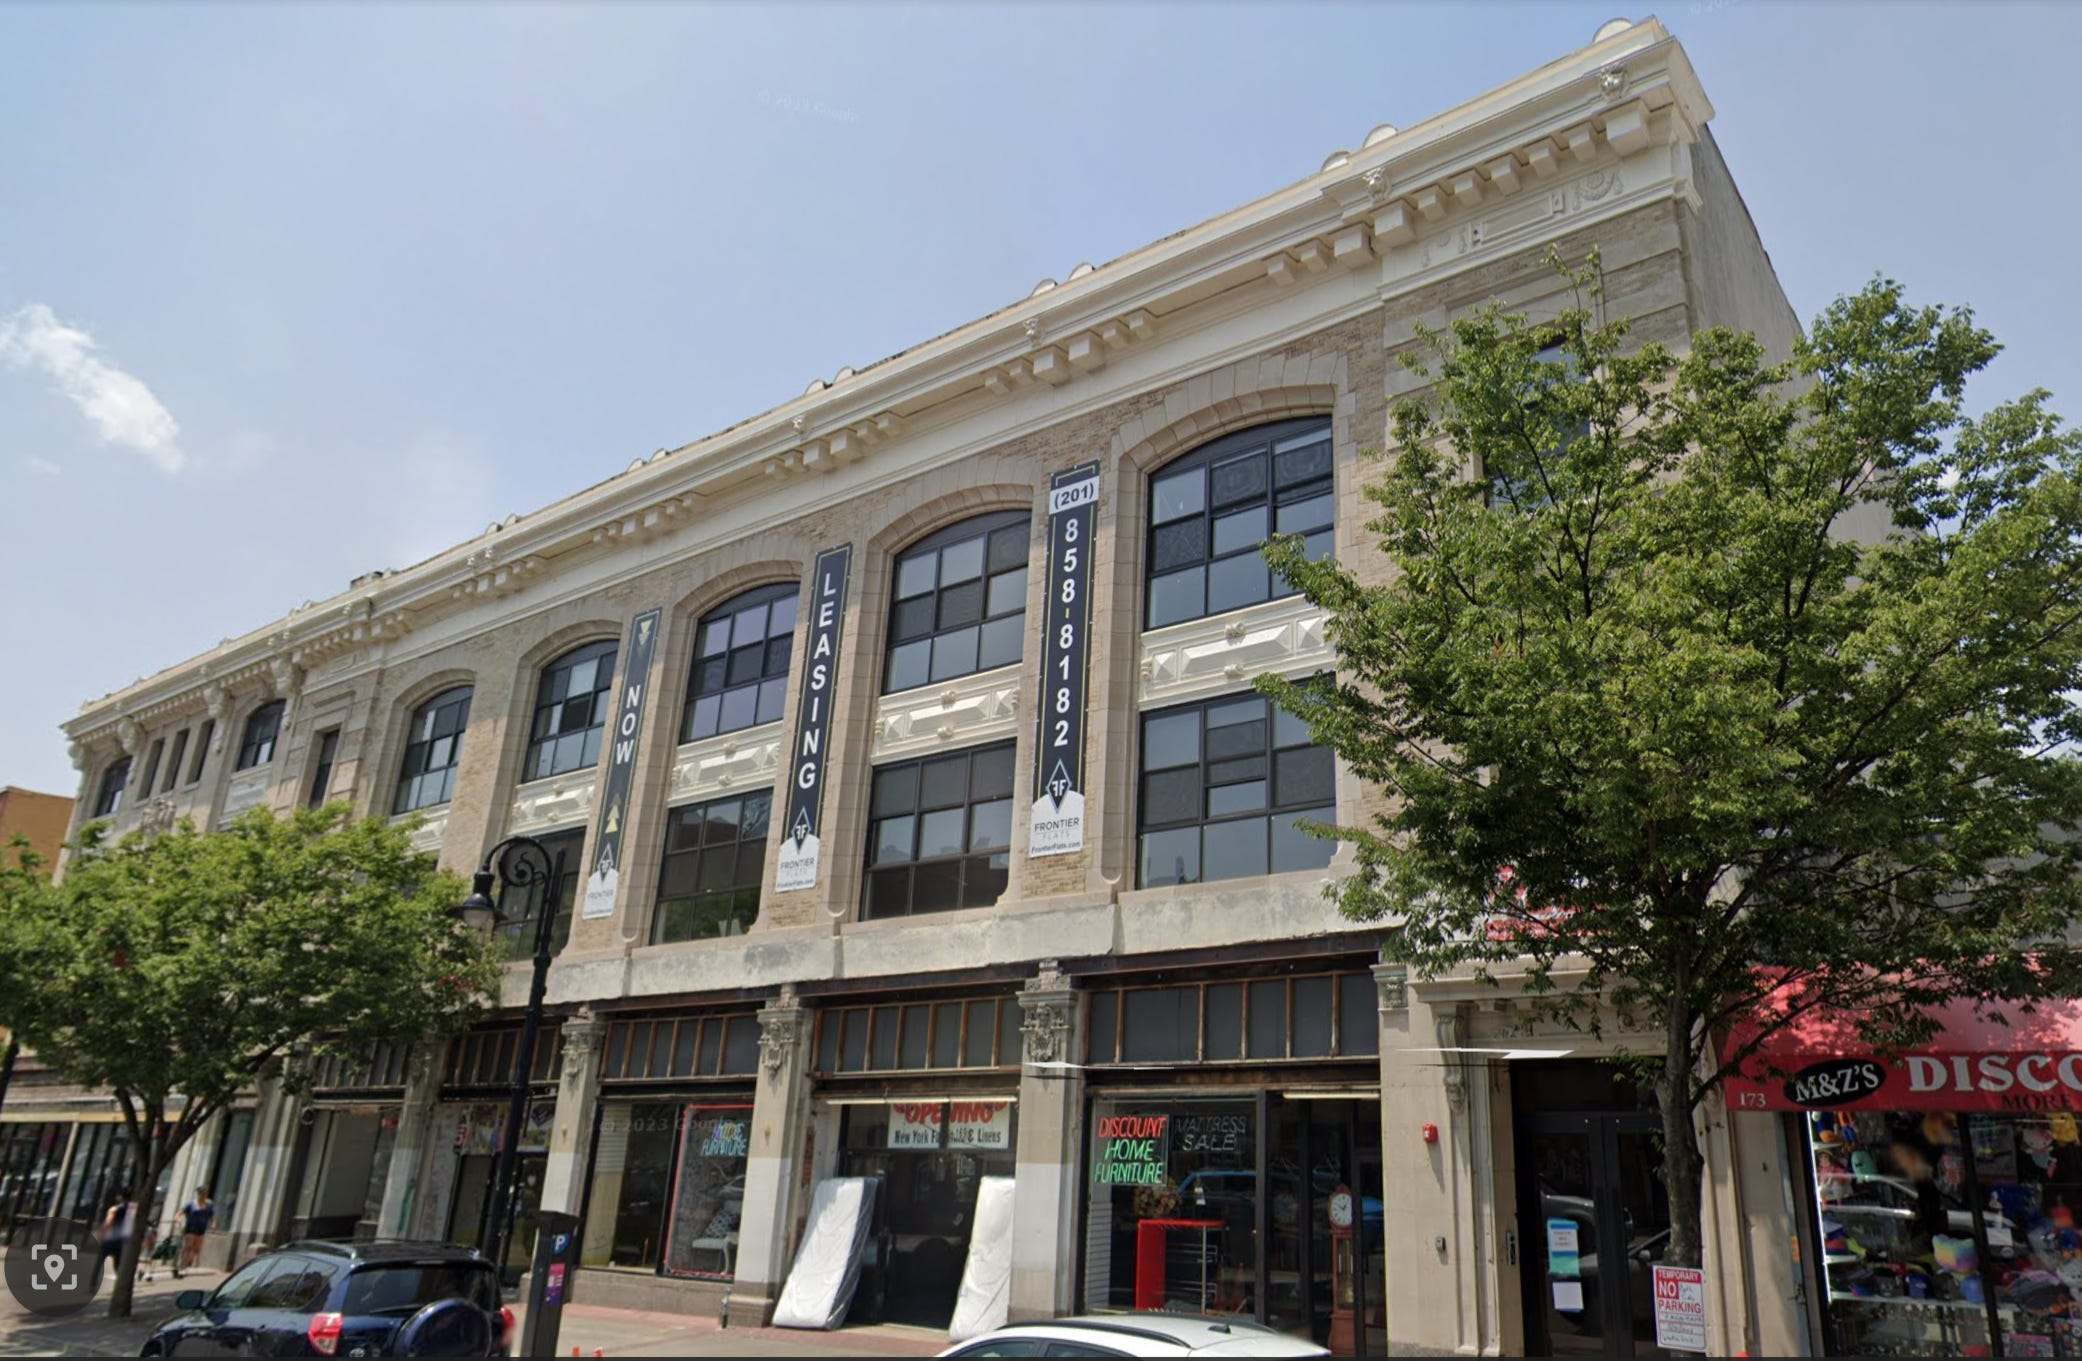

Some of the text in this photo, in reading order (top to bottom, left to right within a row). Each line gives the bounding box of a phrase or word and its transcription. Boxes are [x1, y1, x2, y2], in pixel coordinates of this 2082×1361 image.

[1054, 483, 1094, 511] (201)
[799, 572, 837, 790] LEASING
[616, 684, 641, 765] NOW
[1034, 817, 1080, 833] FRONTIER
[780, 857, 815, 870] FRONTIER
[1795, 1063, 1879, 1102] M&Z'S
[1739, 1092, 1766, 1108] 173
[2001, 1093, 2069, 1111] MORE
[1098, 1116, 1167, 1138] DISCOUNT
[1175, 1115, 1247, 1134] MATTRESS
[894, 1130, 911, 1144] New
[912, 1129, 929, 1144] York
[977, 1128, 1001, 1144] Linens
[1182, 1134, 1236, 1151] SALE
[1104, 1138, 1154, 1160] HOME
[1094, 1162, 1164, 1184] FURNITURE
[1657, 1268, 1700, 1281] TEMPORARY
[1658, 1280, 1677, 1298] NO
[1658, 1300, 1702, 1314] PARKING
